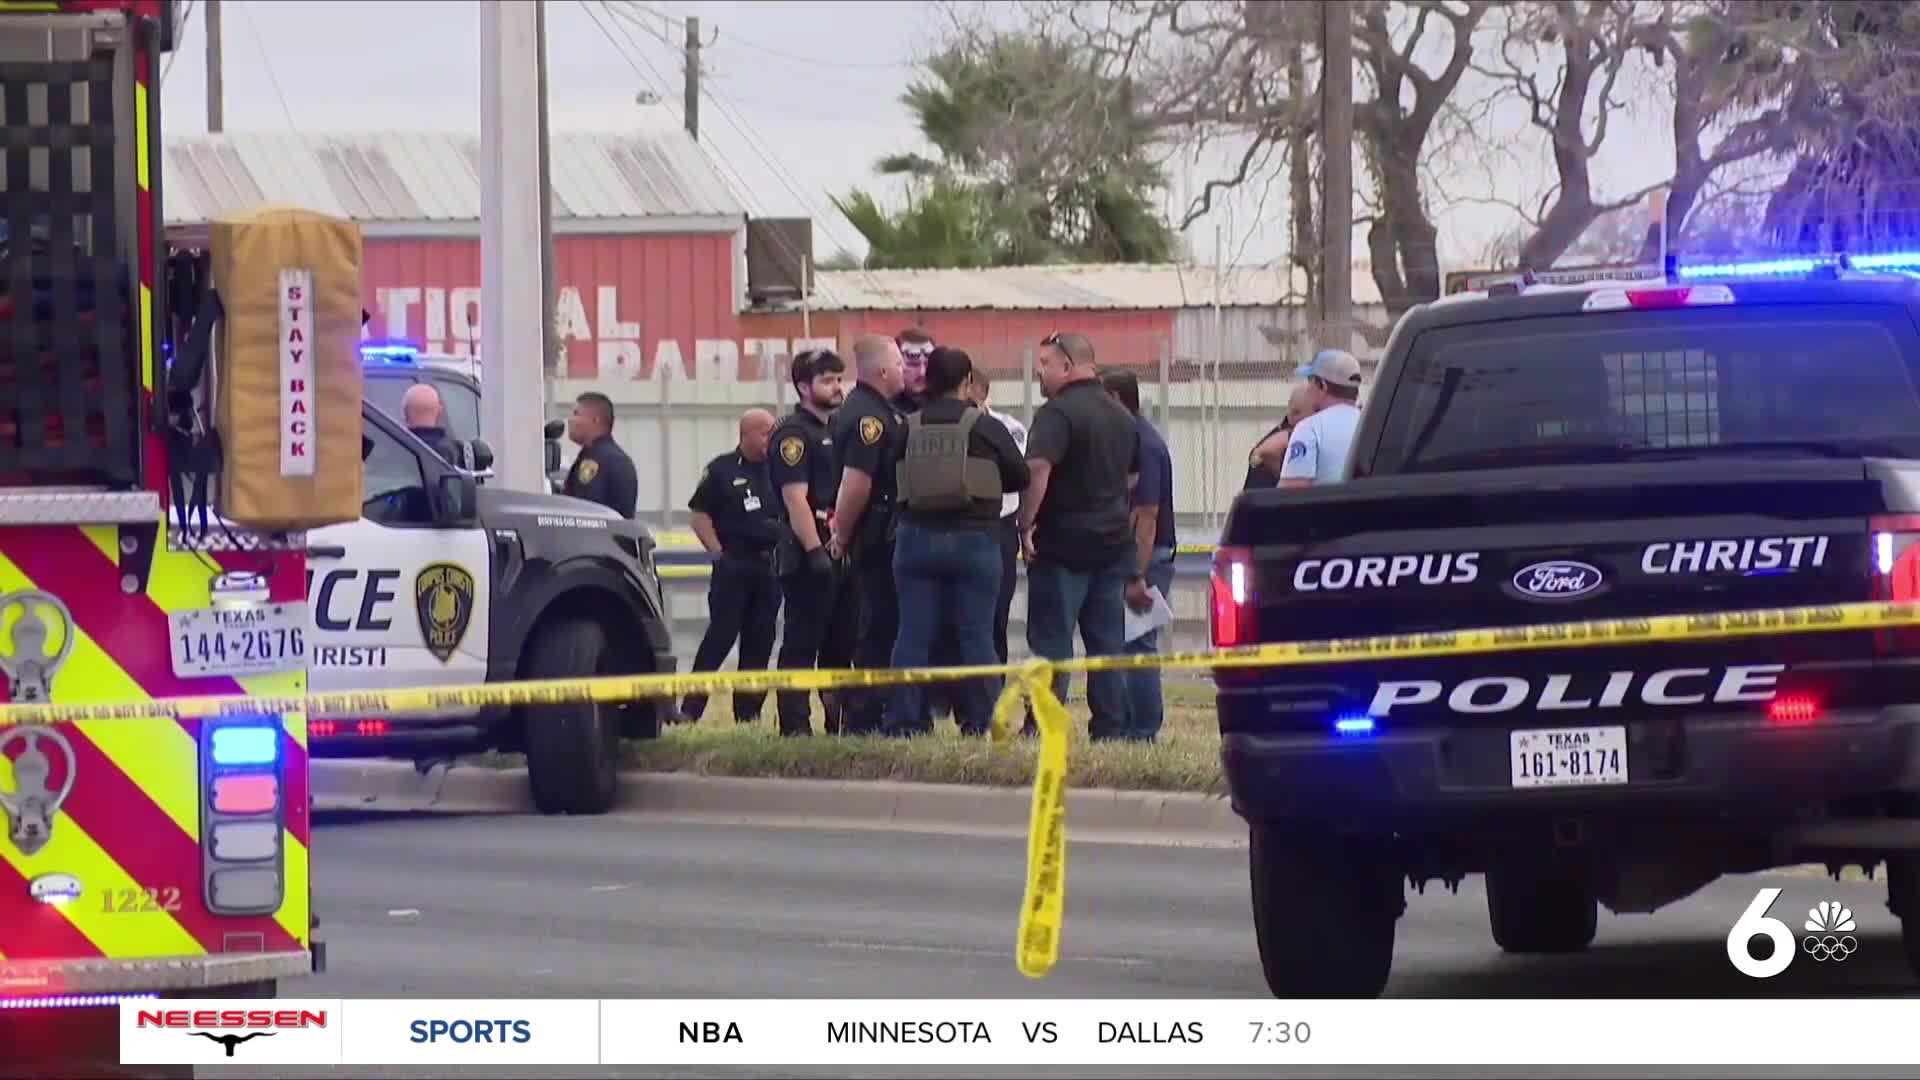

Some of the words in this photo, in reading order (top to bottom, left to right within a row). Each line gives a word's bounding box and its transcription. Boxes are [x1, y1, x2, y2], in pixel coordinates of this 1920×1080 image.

[287, 286, 303, 364] STAY
[290, 379, 306, 457] BACK
[1293, 552, 1479, 591] CORPUS
[1641, 536, 1828, 574] CHRISTI
[1528, 567, 1584, 591] Ford
[213, 608, 265, 624] TEXAS
[1368, 664, 1785, 716] POLICE
[1547, 732, 1590, 745] TEXAS
[100, 886, 182, 912] 1222
